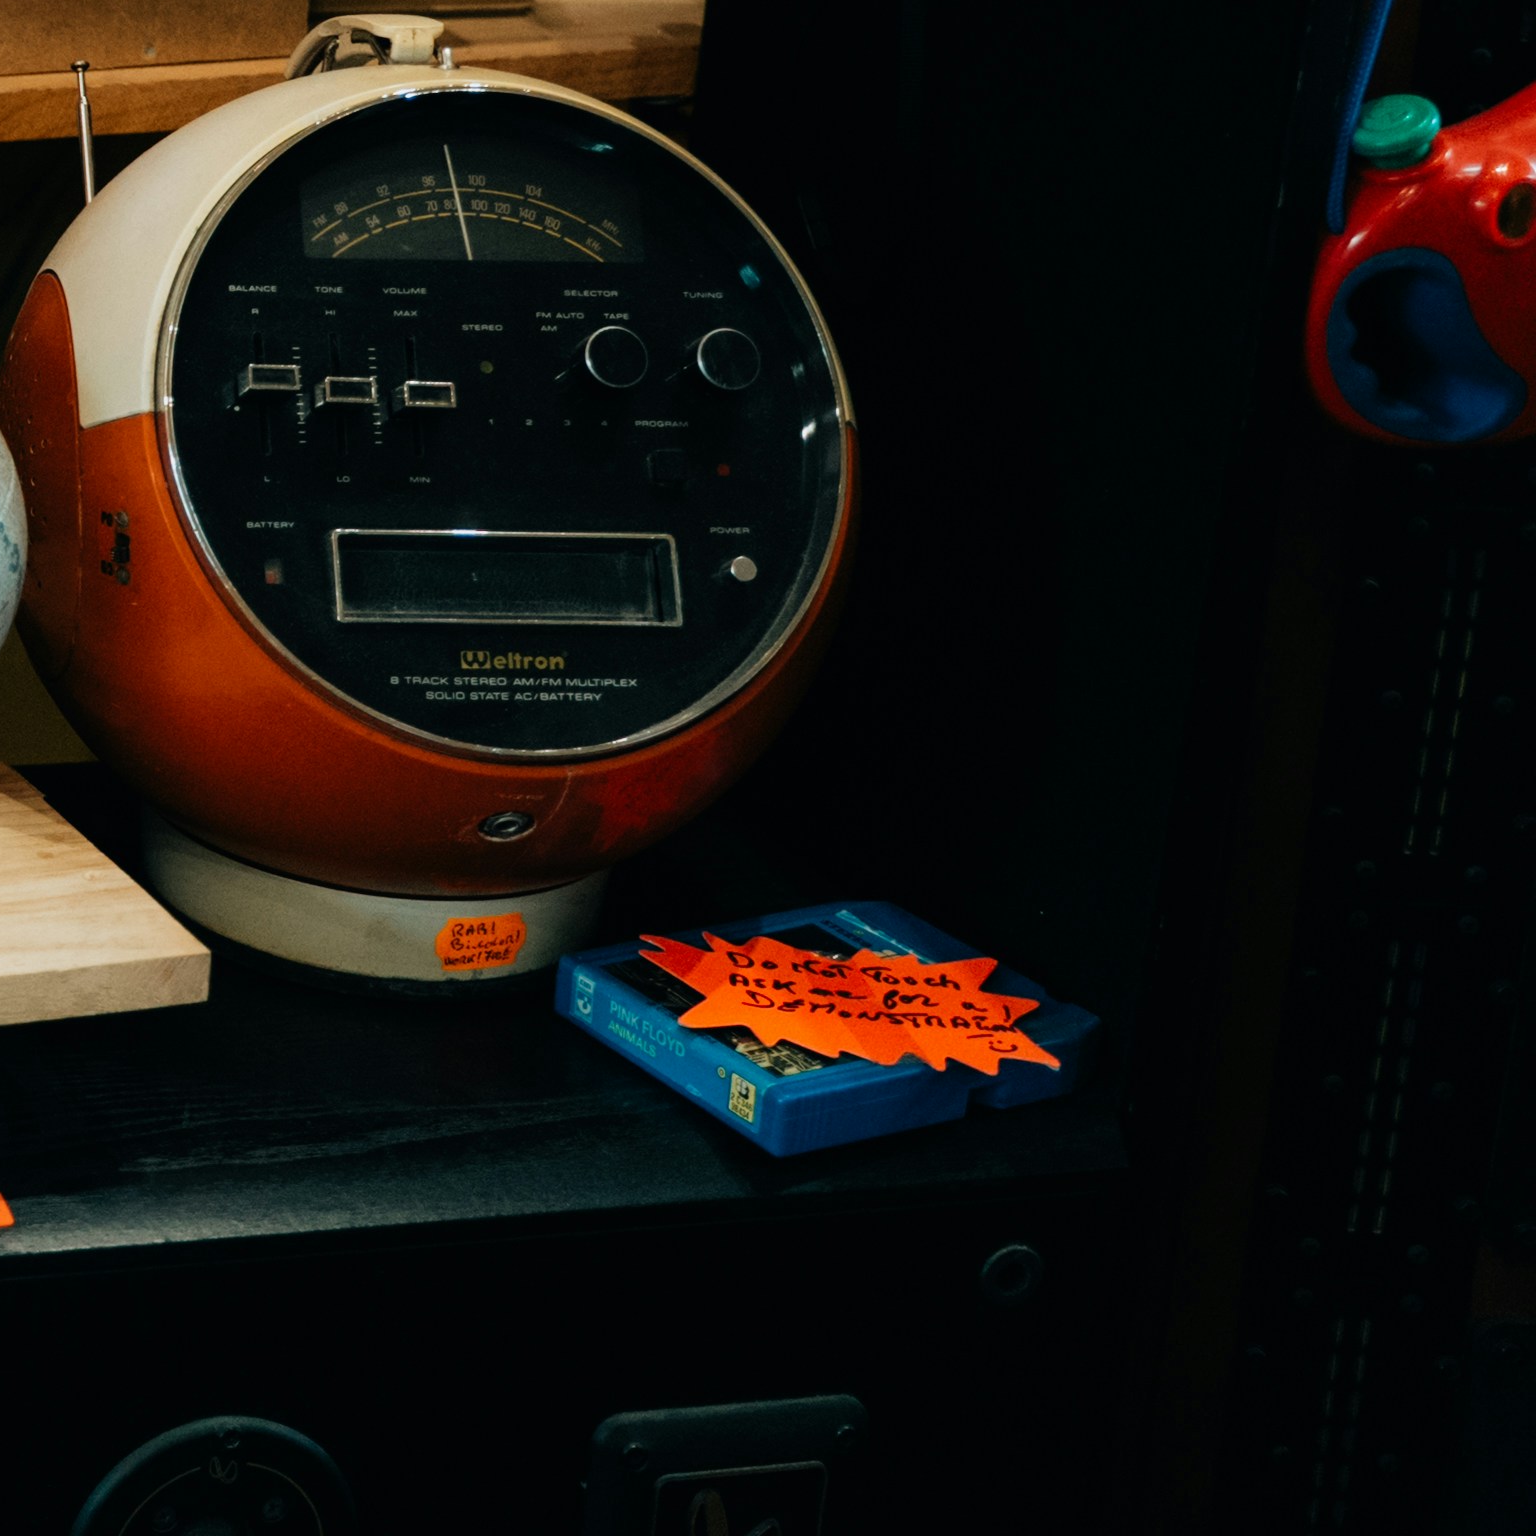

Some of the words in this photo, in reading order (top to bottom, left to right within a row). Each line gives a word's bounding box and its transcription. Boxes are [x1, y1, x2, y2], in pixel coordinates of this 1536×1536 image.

[312, 213, 331, 230] FM
[375, 184, 392, 198] 92
[421, 176, 437, 189] 96
[467, 175, 487, 189] 100
[524, 184, 544, 199] 104
[332, 232, 352, 248] AM
[395, 203, 413, 220] 60
[425, 199, 439, 214] 70
[469, 199, 490, 213] 100
[492, 201, 512, 216] 120
[516, 204, 538, 222] 140
[542, 213, 563, 232] 160
[228, 284, 278, 294] BALANCE
[314, 285, 344, 295] TONE
[382, 286, 429, 296] VOLUME
[563, 288, 619, 298] SELECTOR
[682, 290, 725, 300] TUNING
[324, 308, 337, 316] HI
[392, 308, 419, 317] MAX
[535, 310, 553, 320] FM
[555, 311, 586, 321] AUTO
[603, 312, 630, 322] TAPE
[461, 323, 505, 333] STEREO
[540, 324, 559, 333] AM
[634, 419, 690, 429] PROGRAM
[409, 475, 432, 484] MIN
[246, 520, 295, 530] BATTERY
[709, 526, 751, 536] POWER
[460, 650, 566, 670] Weltron
[390, 675, 400, 686] 8
[404, 675, 449, 686] TRACK
[453, 675, 508, 687] STEREO
[512, 676, 563, 687] AM/FM
[565, 676, 639, 689] MULTIPLEX
[425, 690, 466, 702] SOLID
[469, 691, 510, 702] STATE
[514, 691, 603, 703] AC/BATTERY
[609, 1000, 640, 1031] PINK
[641, 1024, 687, 1058] FLOYD
[608, 1019, 658, 1059] ANIMALS
